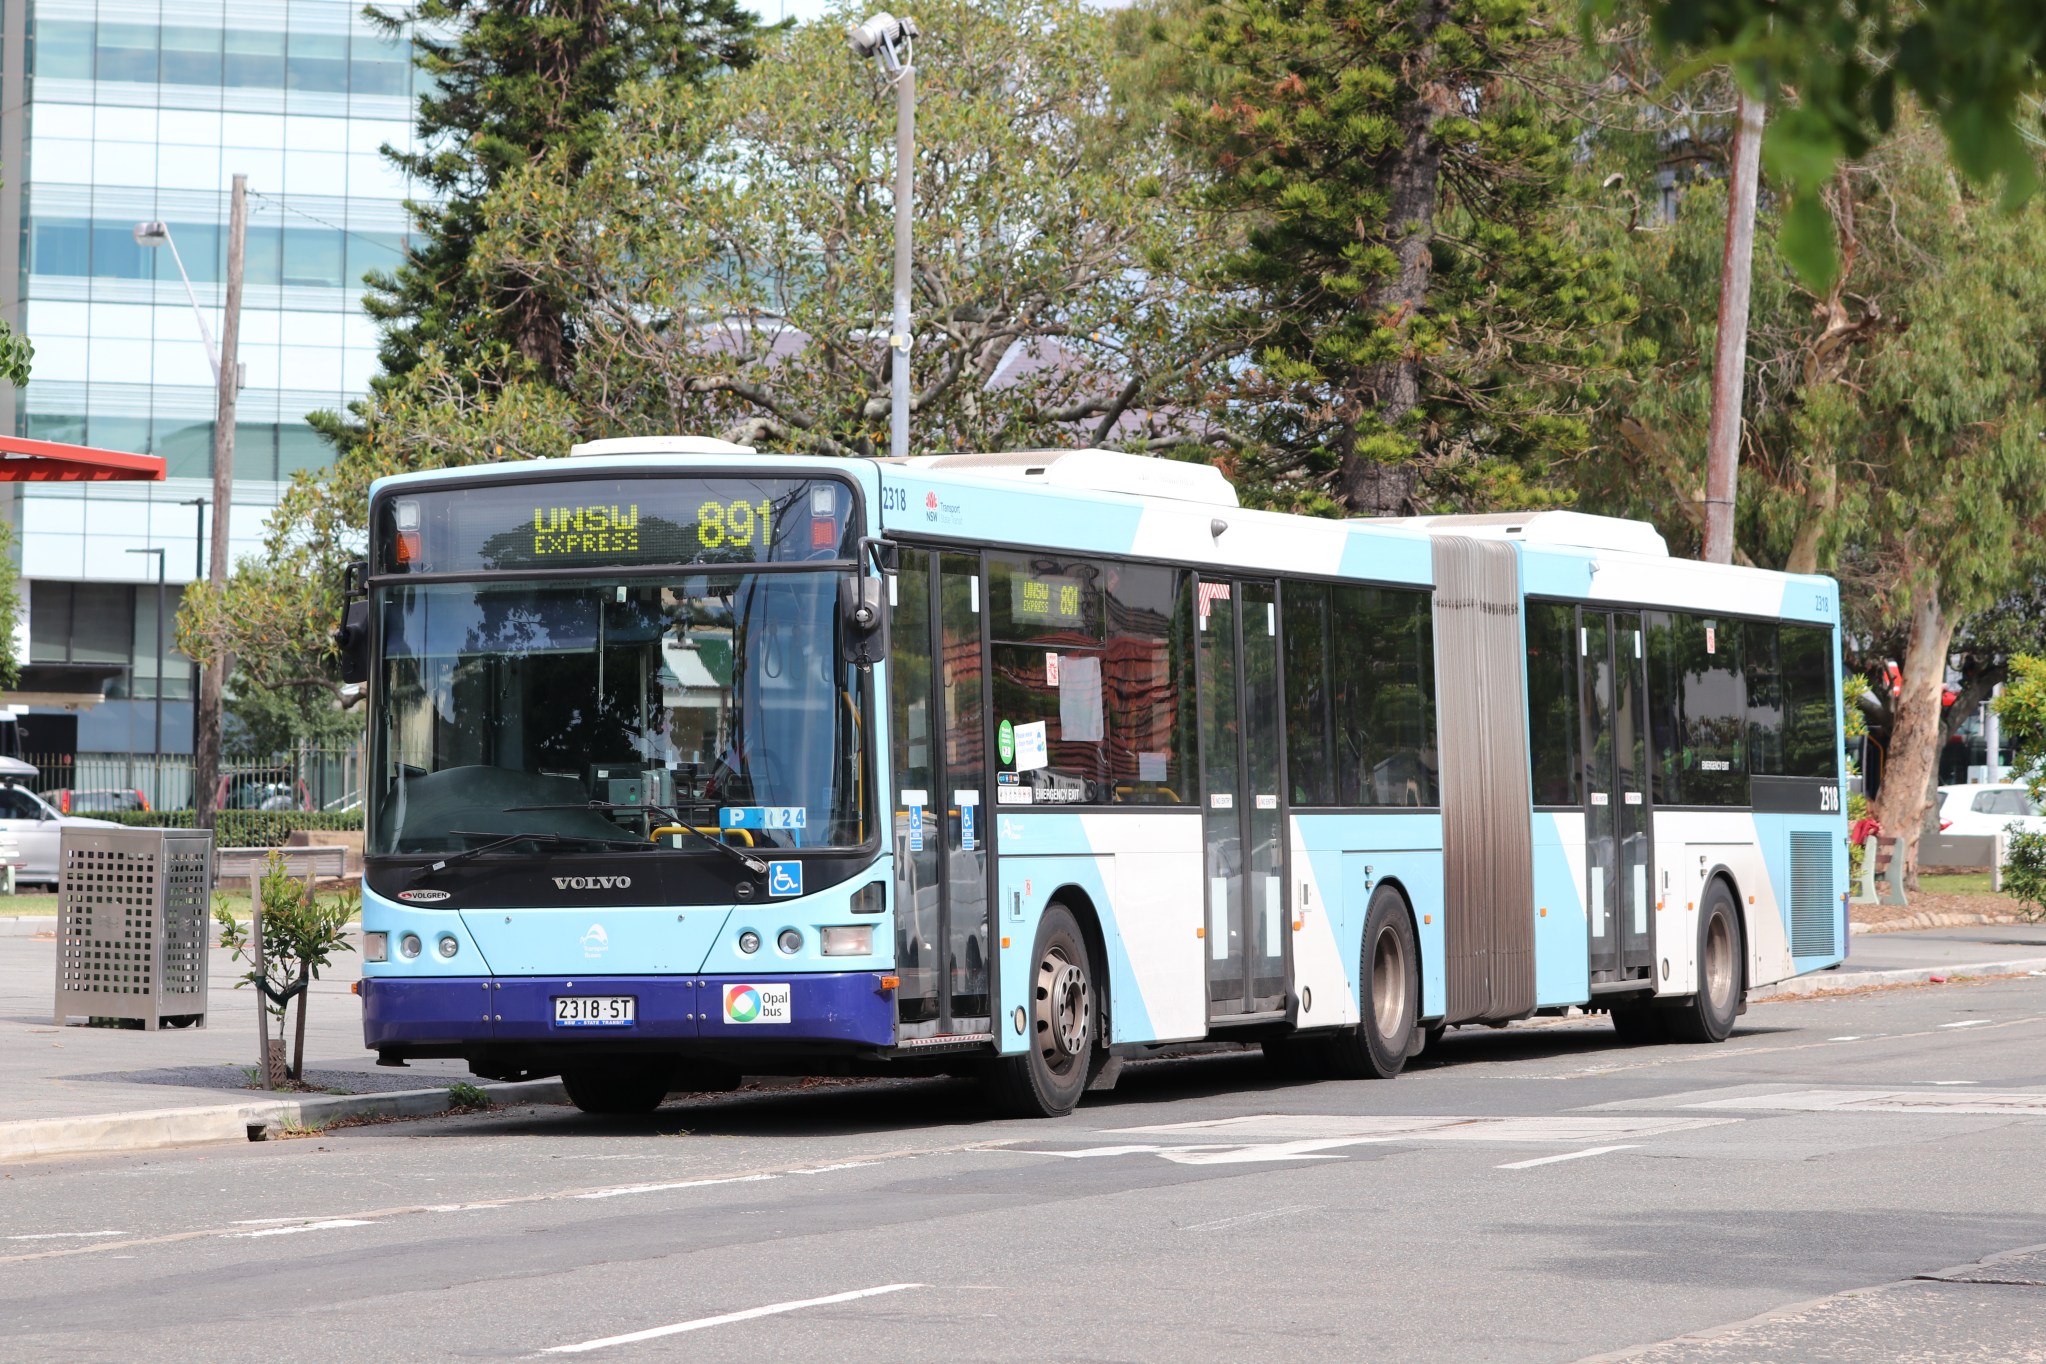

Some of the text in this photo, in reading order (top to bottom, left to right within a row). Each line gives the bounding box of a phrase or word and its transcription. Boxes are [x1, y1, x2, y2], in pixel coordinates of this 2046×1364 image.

[883, 486, 906, 511] 2318
[926, 511, 938, 522] NSW
[940, 502, 961, 514] Transport
[534, 504, 638, 533] UNSW
[698, 499, 771, 548] 891
[535, 531, 638, 554] EXPRESS
[1024, 582, 1049, 600] UNSW
[1023, 599, 1049, 613] EXPRESS
[1815, 595, 1829, 613] 2318
[1036, 788, 1068, 800] EMERGENCY
[1068, 788, 1080, 801] EXIT
[1820, 785, 1839, 811] 2318
[729, 808, 745, 826] P
[552, 876, 632, 890] VOLVO
[763, 991, 788, 1006] Opal
[763, 1005, 782, 1017] bus
